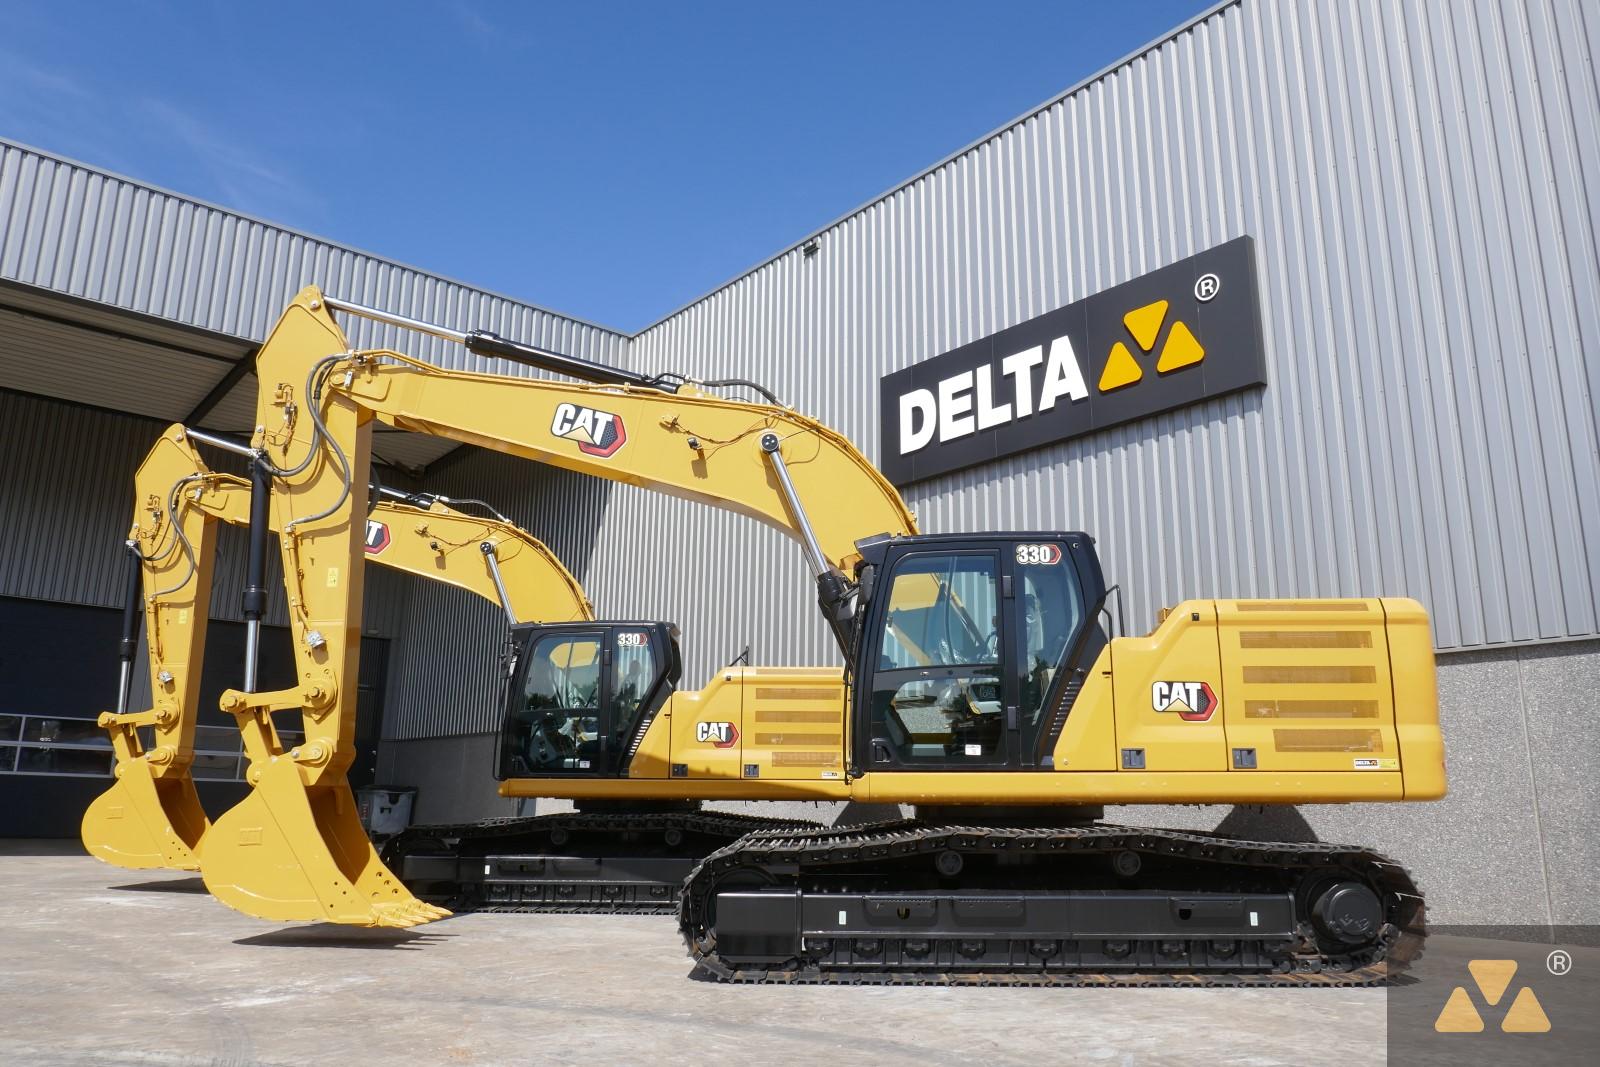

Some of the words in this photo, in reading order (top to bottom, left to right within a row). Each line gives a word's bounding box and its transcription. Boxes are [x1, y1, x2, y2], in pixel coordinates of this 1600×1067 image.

[899, 335, 1089, 456] DELTA
[551, 403, 614, 446] CAT
[1017, 545, 1051, 563] 330
[618, 633, 641, 645] 330
[1152, 682, 1202, 712] CAT
[697, 722, 729, 742] CAT
